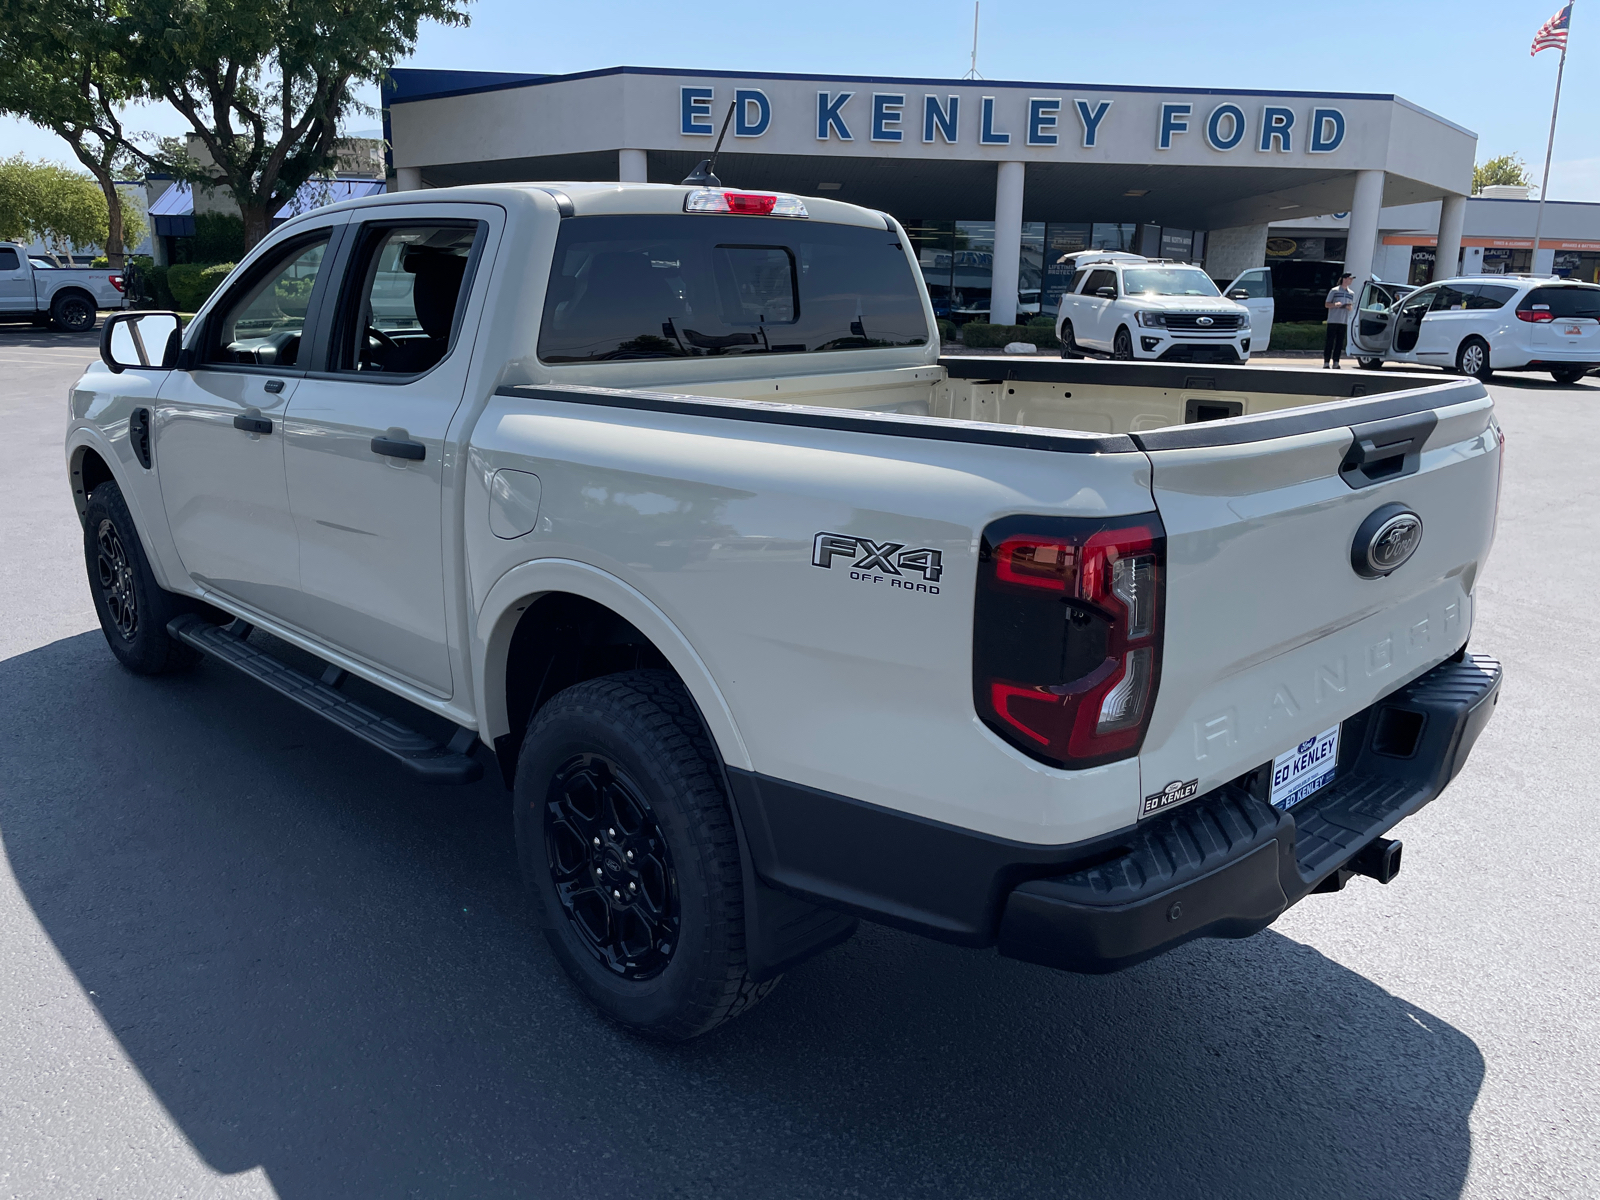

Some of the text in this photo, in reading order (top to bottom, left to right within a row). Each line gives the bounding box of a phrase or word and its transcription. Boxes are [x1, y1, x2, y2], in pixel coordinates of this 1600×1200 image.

[680, 85, 1347, 154] ED KENLEY FORD
[811, 531, 943, 583] FX4
[1384, 526, 1416, 560] Ford
[850, 571, 940, 595] OFF ROAD
[1274, 764, 1290, 787] ED
[1292, 737, 1335, 776] KENLEY
[1145, 783, 1198, 811] ED KENLEY
[1285, 793, 1297, 808] ED
[1296, 775, 1325, 800] KENLEY
